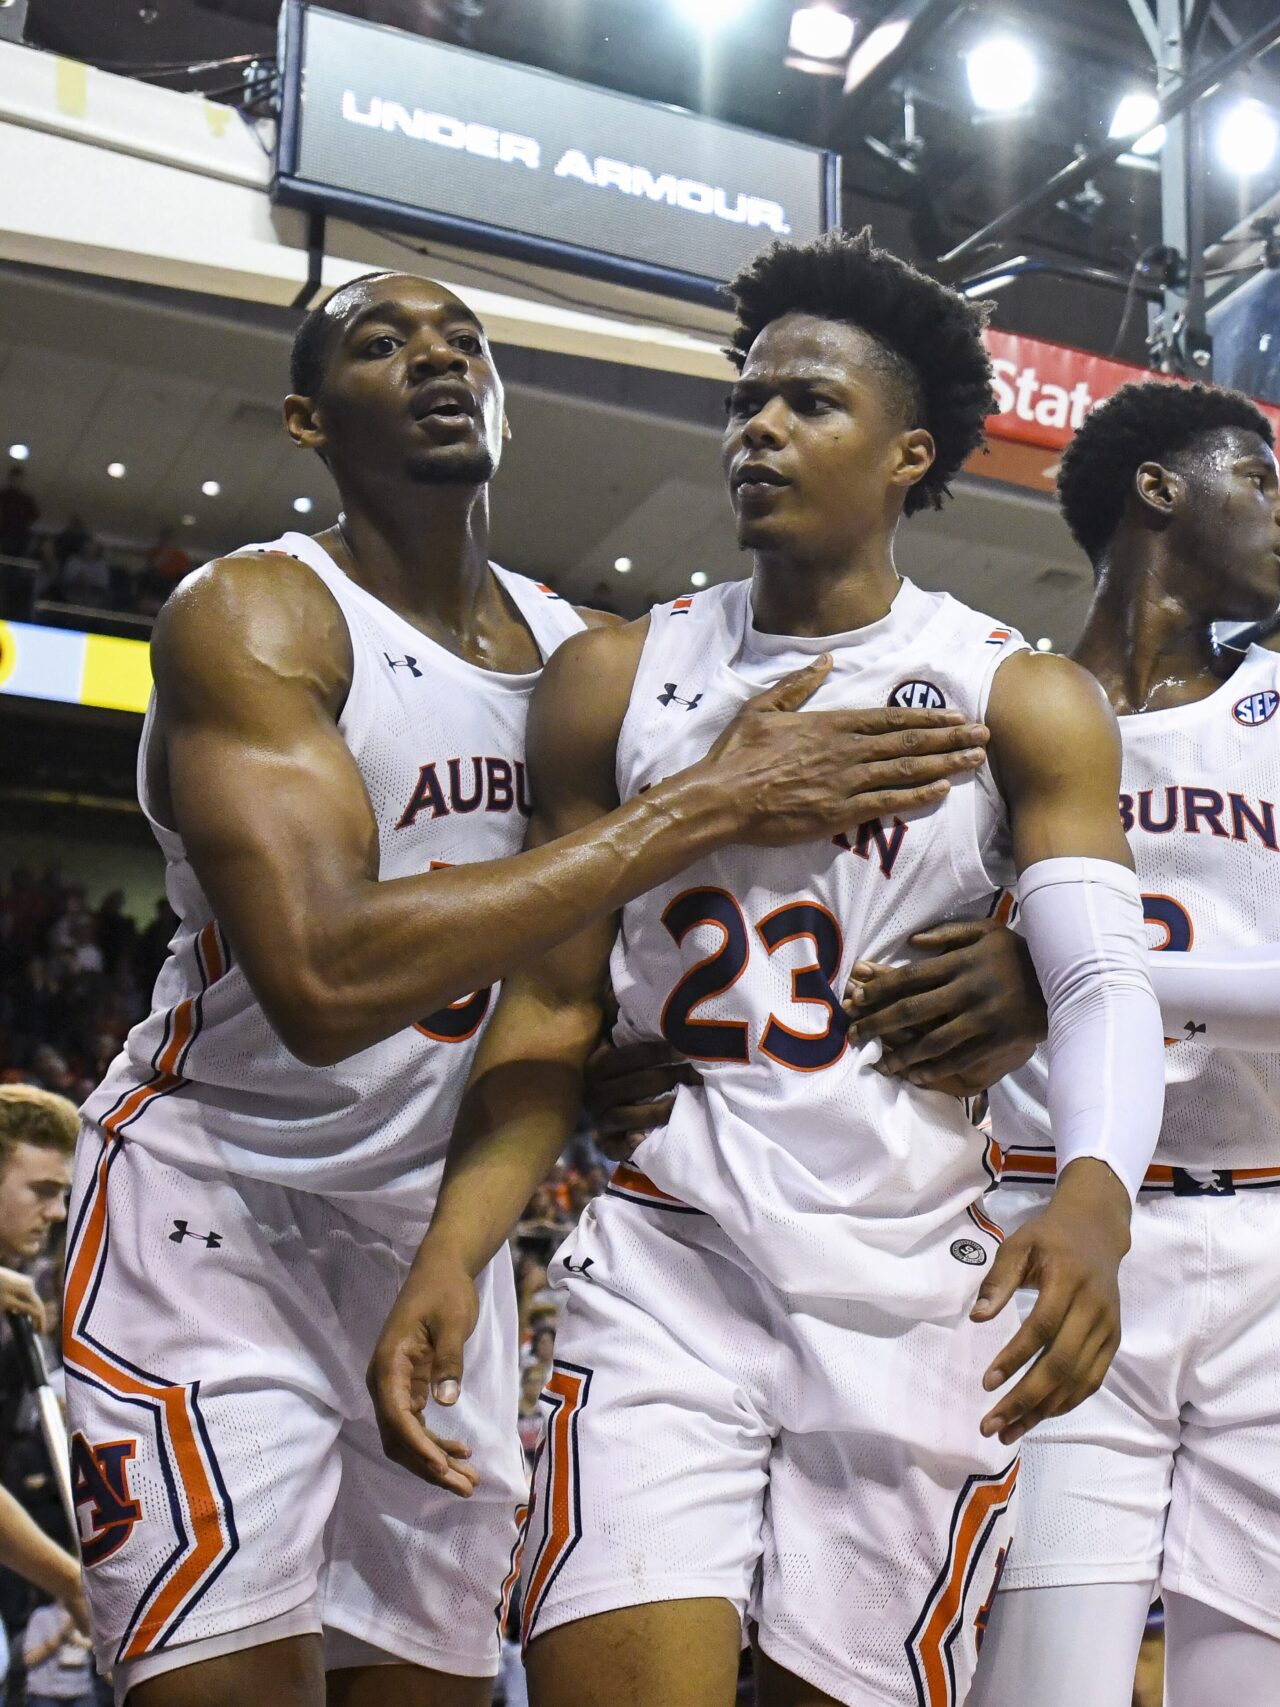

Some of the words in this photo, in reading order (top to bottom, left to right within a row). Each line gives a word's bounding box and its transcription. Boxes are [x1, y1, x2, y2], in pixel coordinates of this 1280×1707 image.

[343, 90, 541, 169] UNDER
[988, 358, 1108, 430] Stat
[1236, 692, 1277, 723] SEC
[660, 885, 850, 1073] 23
